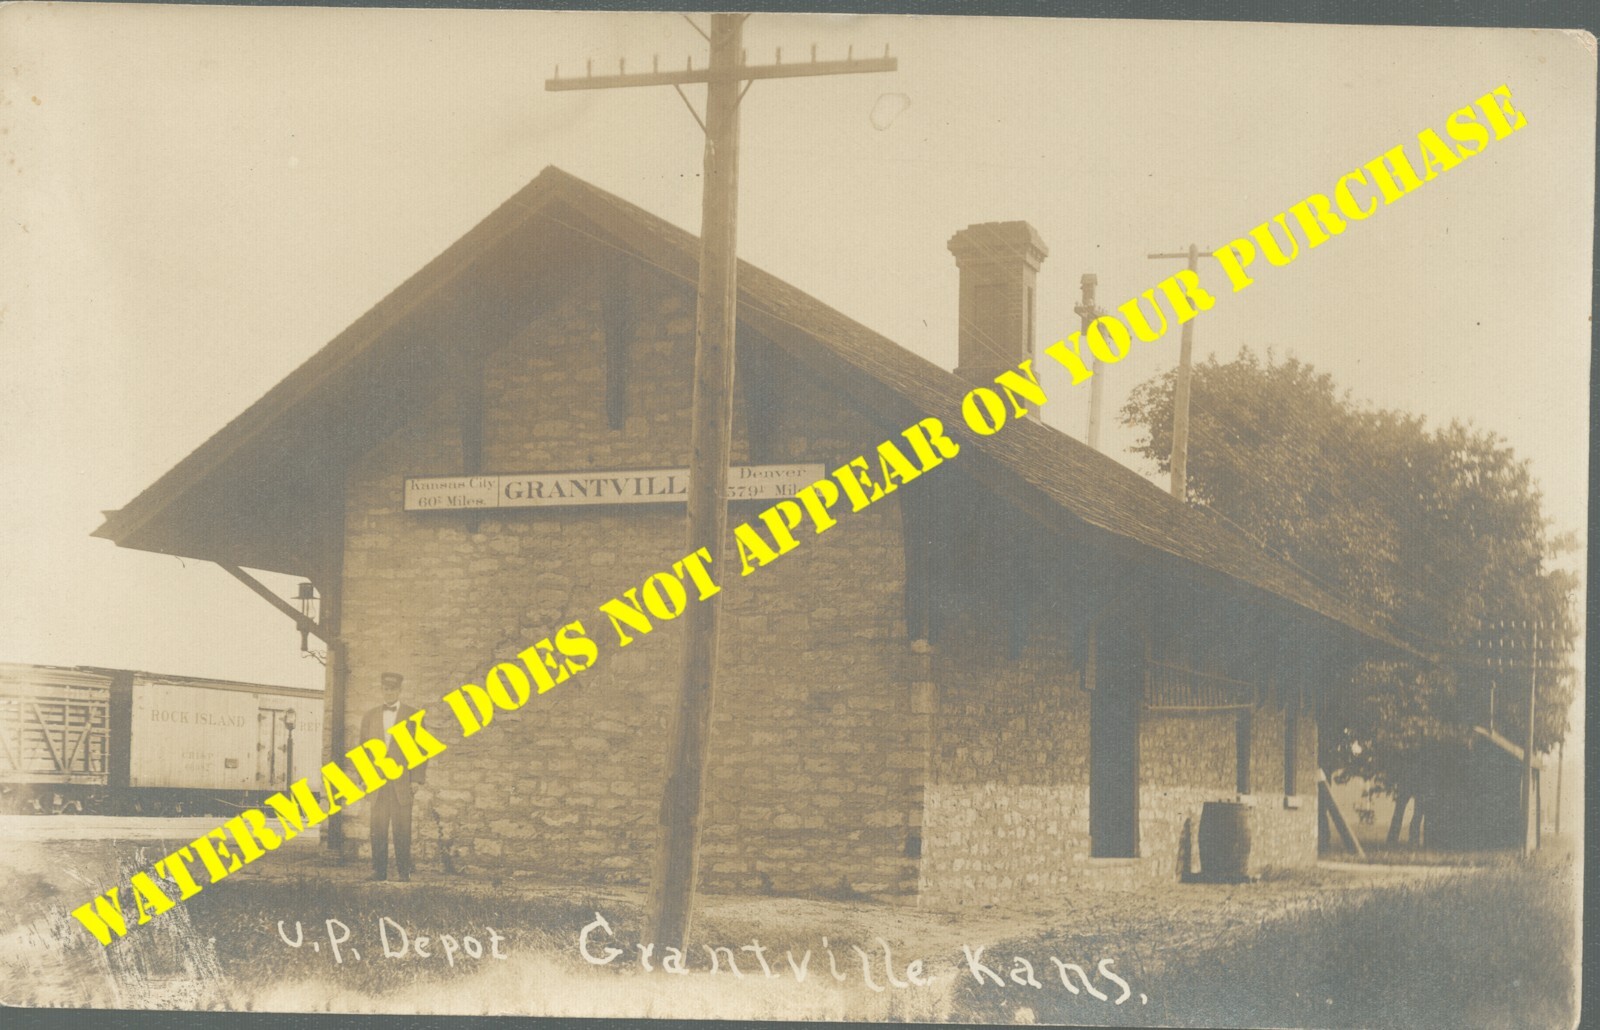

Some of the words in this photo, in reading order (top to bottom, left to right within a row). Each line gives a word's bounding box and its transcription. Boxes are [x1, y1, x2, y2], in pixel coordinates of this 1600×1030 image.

[740, 467, 807, 479] Denver
[411, 479, 465, 491] Kansas
[469, 477, 495, 491] City
[504, 475, 690, 500] GRANTVILL
[151, 709, 189, 724] ROCK
[194, 712, 246, 729] ISLAND
[379, 916, 508, 967] Depot
[579, 911, 937, 993] Grantville
